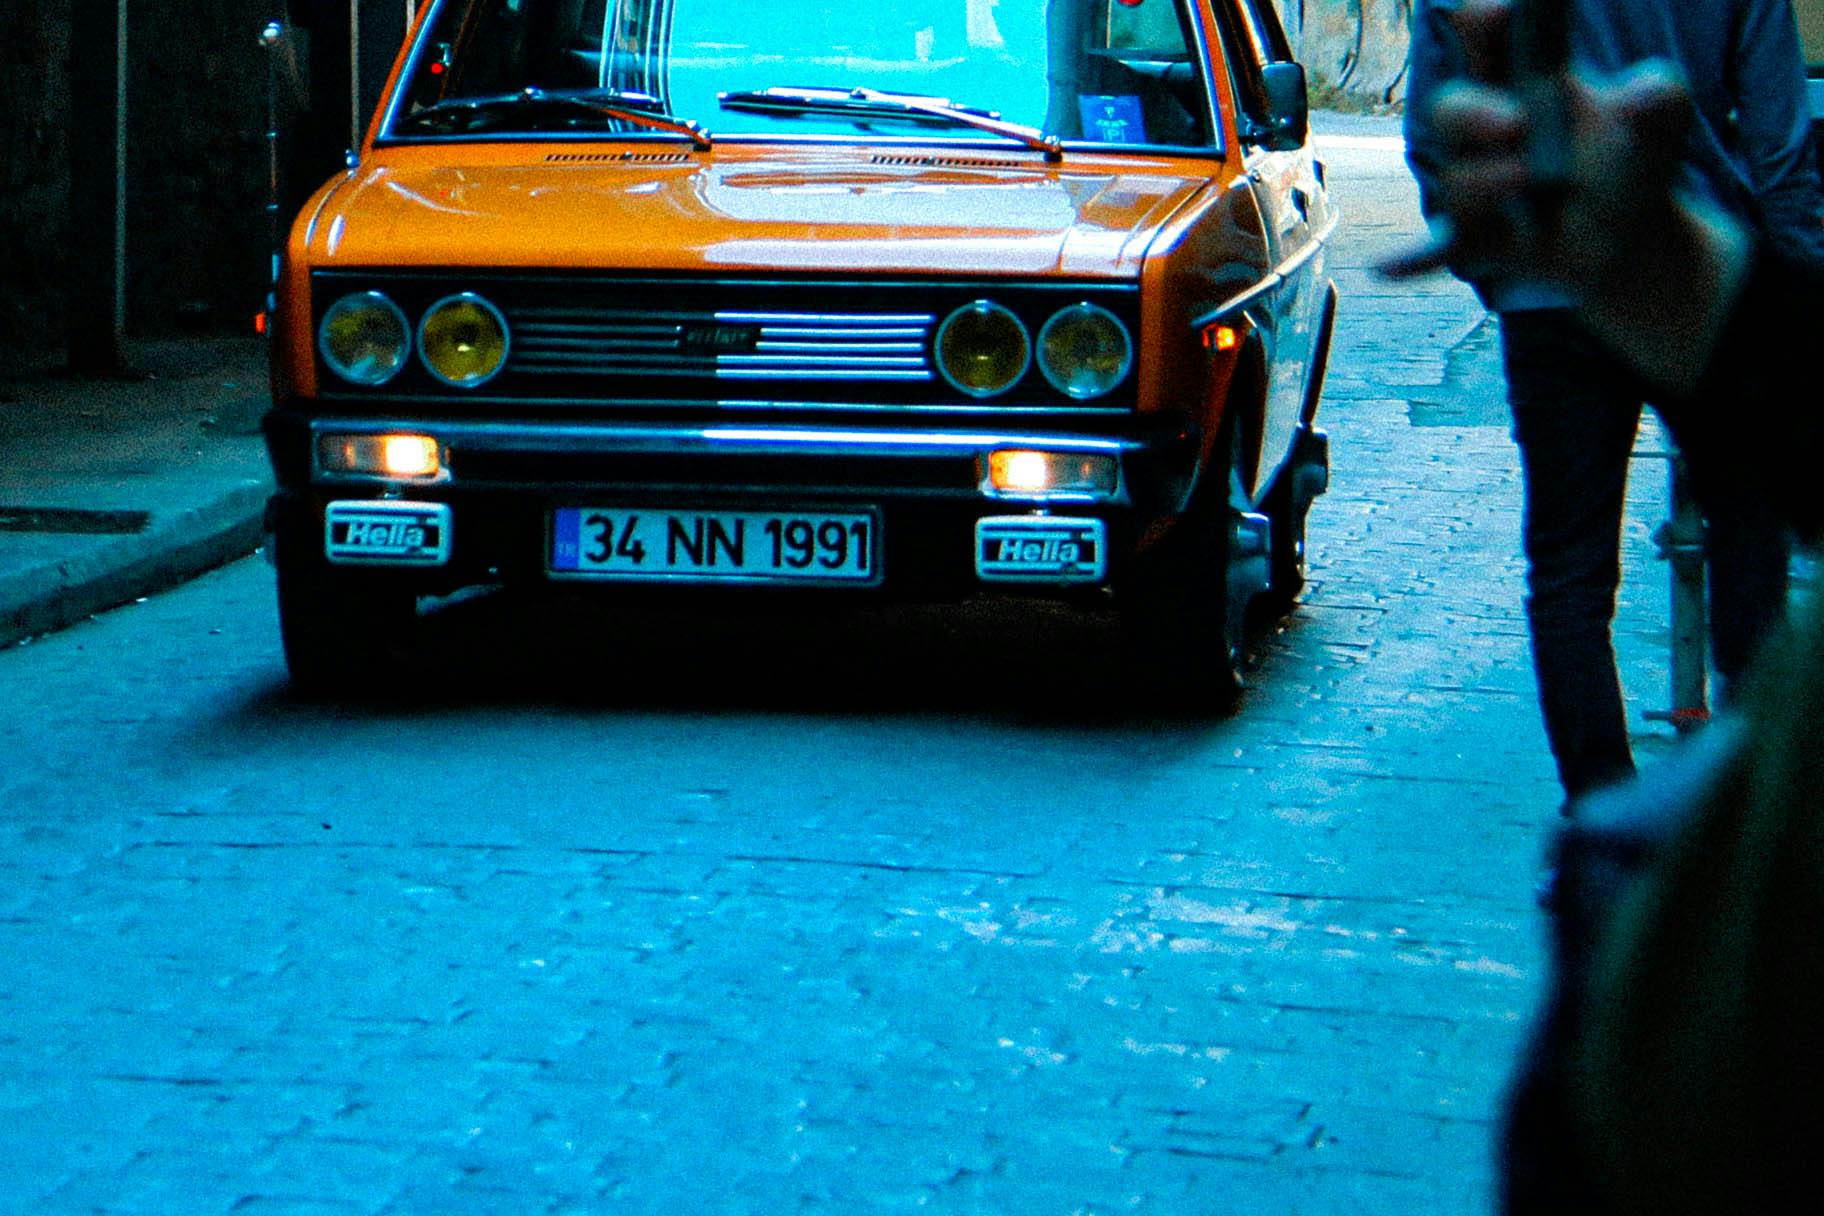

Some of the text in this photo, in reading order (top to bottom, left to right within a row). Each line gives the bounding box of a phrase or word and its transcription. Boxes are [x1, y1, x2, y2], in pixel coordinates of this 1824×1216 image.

[346, 522, 425, 547] Hella
[585, 514, 869, 570] 34 NN 1991
[997, 539, 1079, 563] Hella
